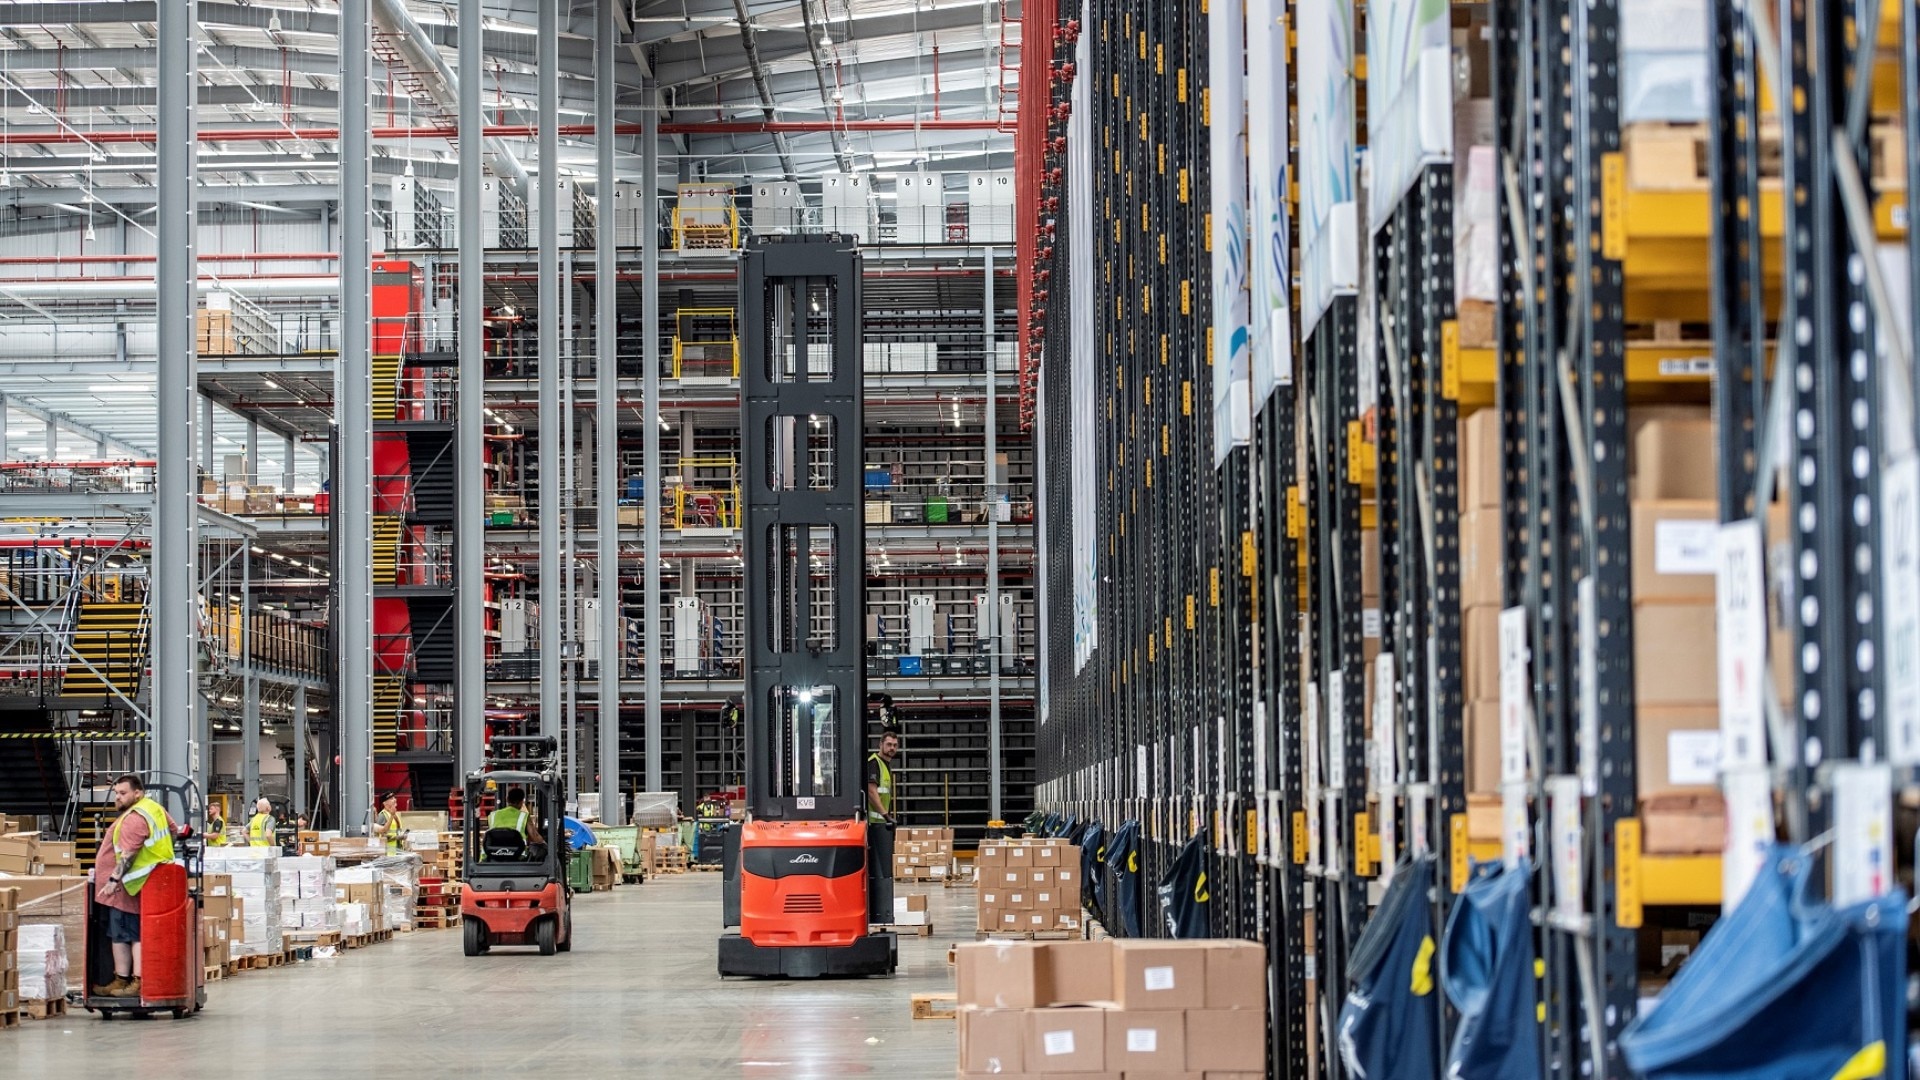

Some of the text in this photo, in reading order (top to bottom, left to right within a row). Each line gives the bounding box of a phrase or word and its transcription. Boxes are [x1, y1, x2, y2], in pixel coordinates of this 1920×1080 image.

[831, 178, 837, 187] 7
[905, 178, 932, 186] 8 9
[977, 176, 1008, 186] 9 10
[400, 182, 406, 191] 2
[484, 182, 490, 191] 3
[614, 190, 642, 198] 4 5
[760, 187, 788, 196] 6 7
[587, 600, 593, 609] 2
[677, 600, 695, 609] 3 4
[912, 597, 931, 606] 6 7
[980, 596, 986, 605] 7
[1003, 596, 1010, 605] 8
[504, 602, 522, 610] 1 2
[789, 853, 819, 864] Linde
